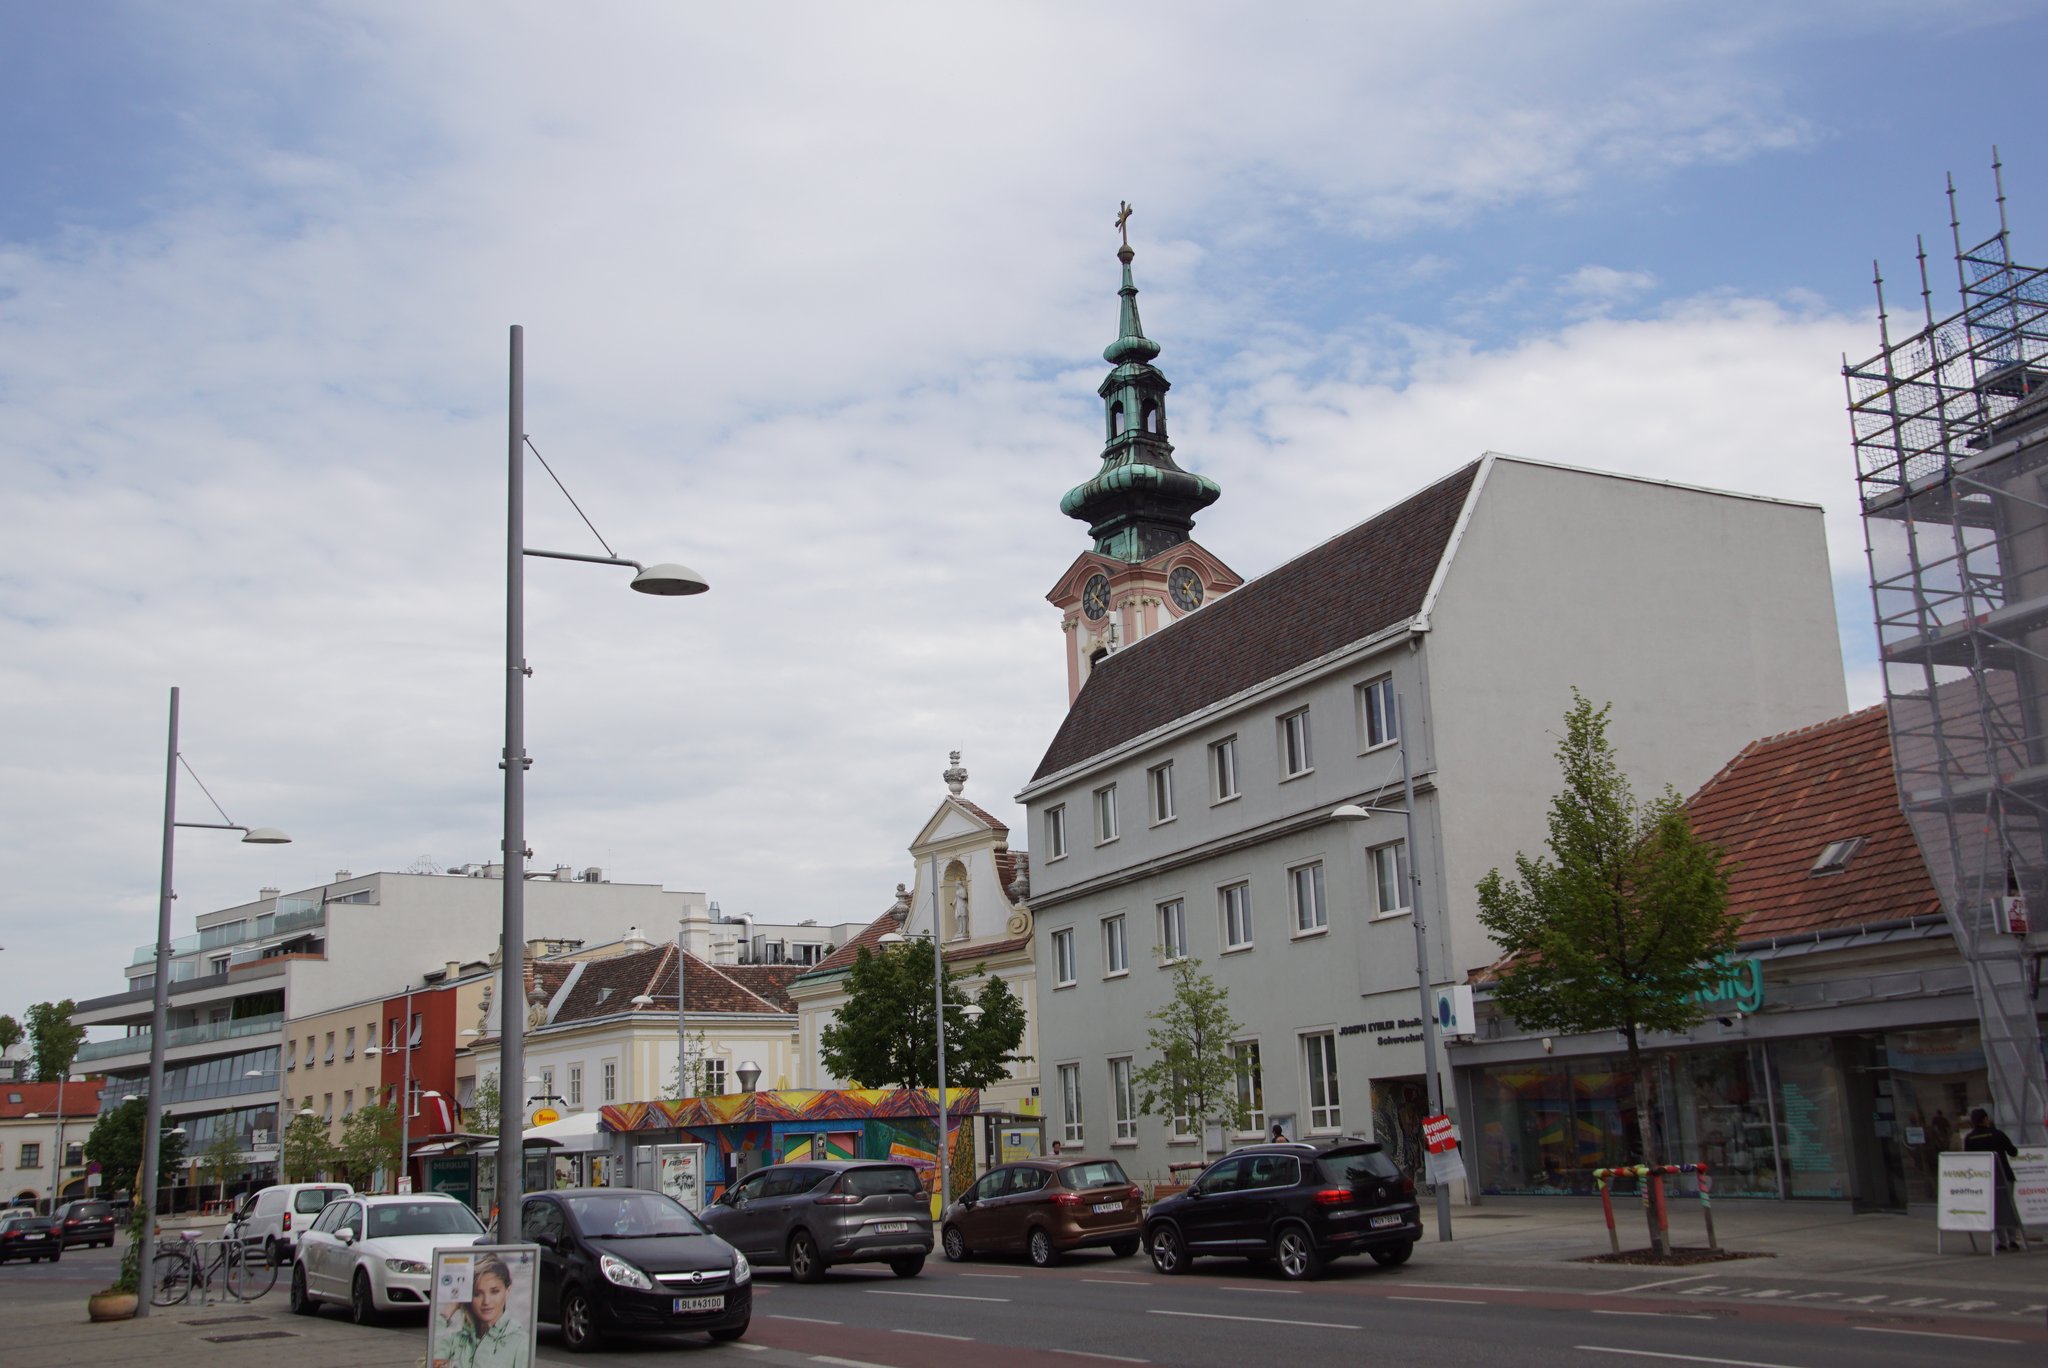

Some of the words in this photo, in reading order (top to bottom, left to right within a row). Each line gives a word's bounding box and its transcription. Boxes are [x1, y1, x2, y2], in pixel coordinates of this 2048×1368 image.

[1339, 1024, 1366, 1036] JOSEPH
[1368, 1021, 1394, 1032] EYBLER
[1378, 1033, 1424, 1046] Schwechat
[1423, 1118, 1450, 1135] Kronen
[1427, 1129, 1456, 1145] Zeitung
[1950, 1188, 1983, 1196] geöffnet
